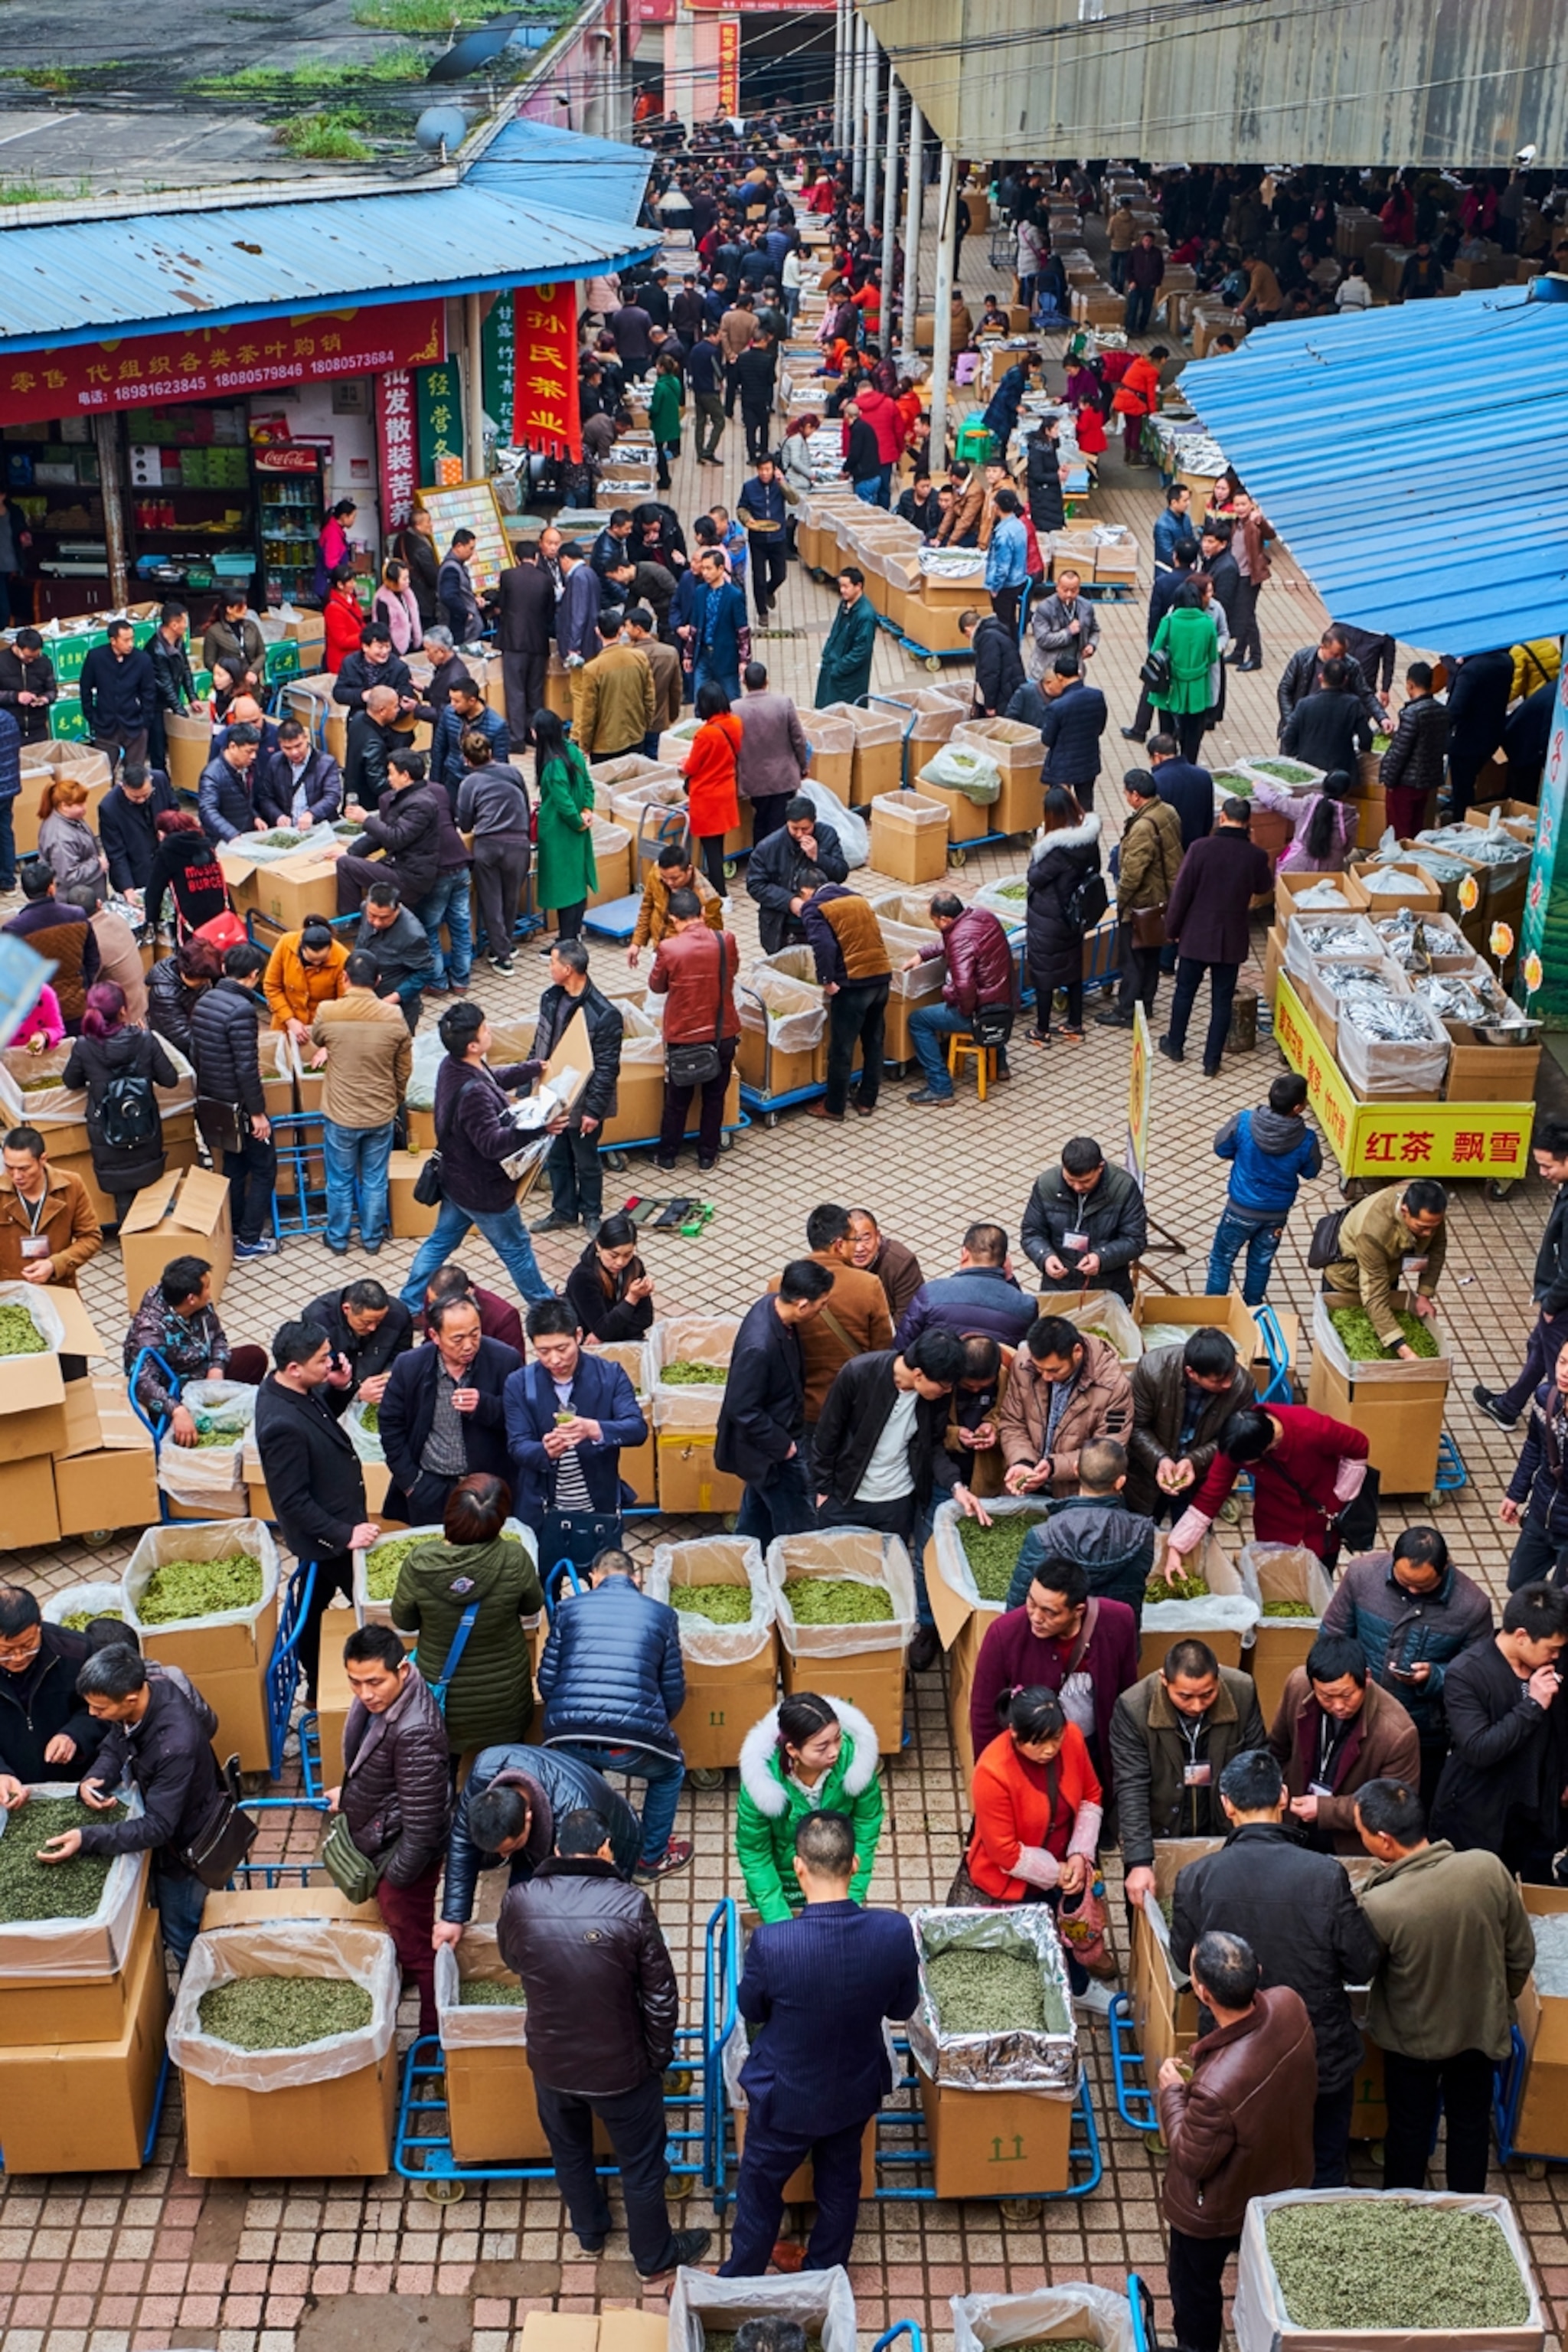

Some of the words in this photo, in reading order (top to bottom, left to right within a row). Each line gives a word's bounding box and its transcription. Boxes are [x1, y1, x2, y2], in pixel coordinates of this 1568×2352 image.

[113, 377, 207, 401] 18981623845
[214, 363, 303, 388] 18080579846
[309, 350, 394, 374] 18080573684
[526, 309, 568, 436] 孙民茶业
[1364, 1131, 1435, 1163] 红茶
[1452, 1132, 1522, 1163] 飘雪
